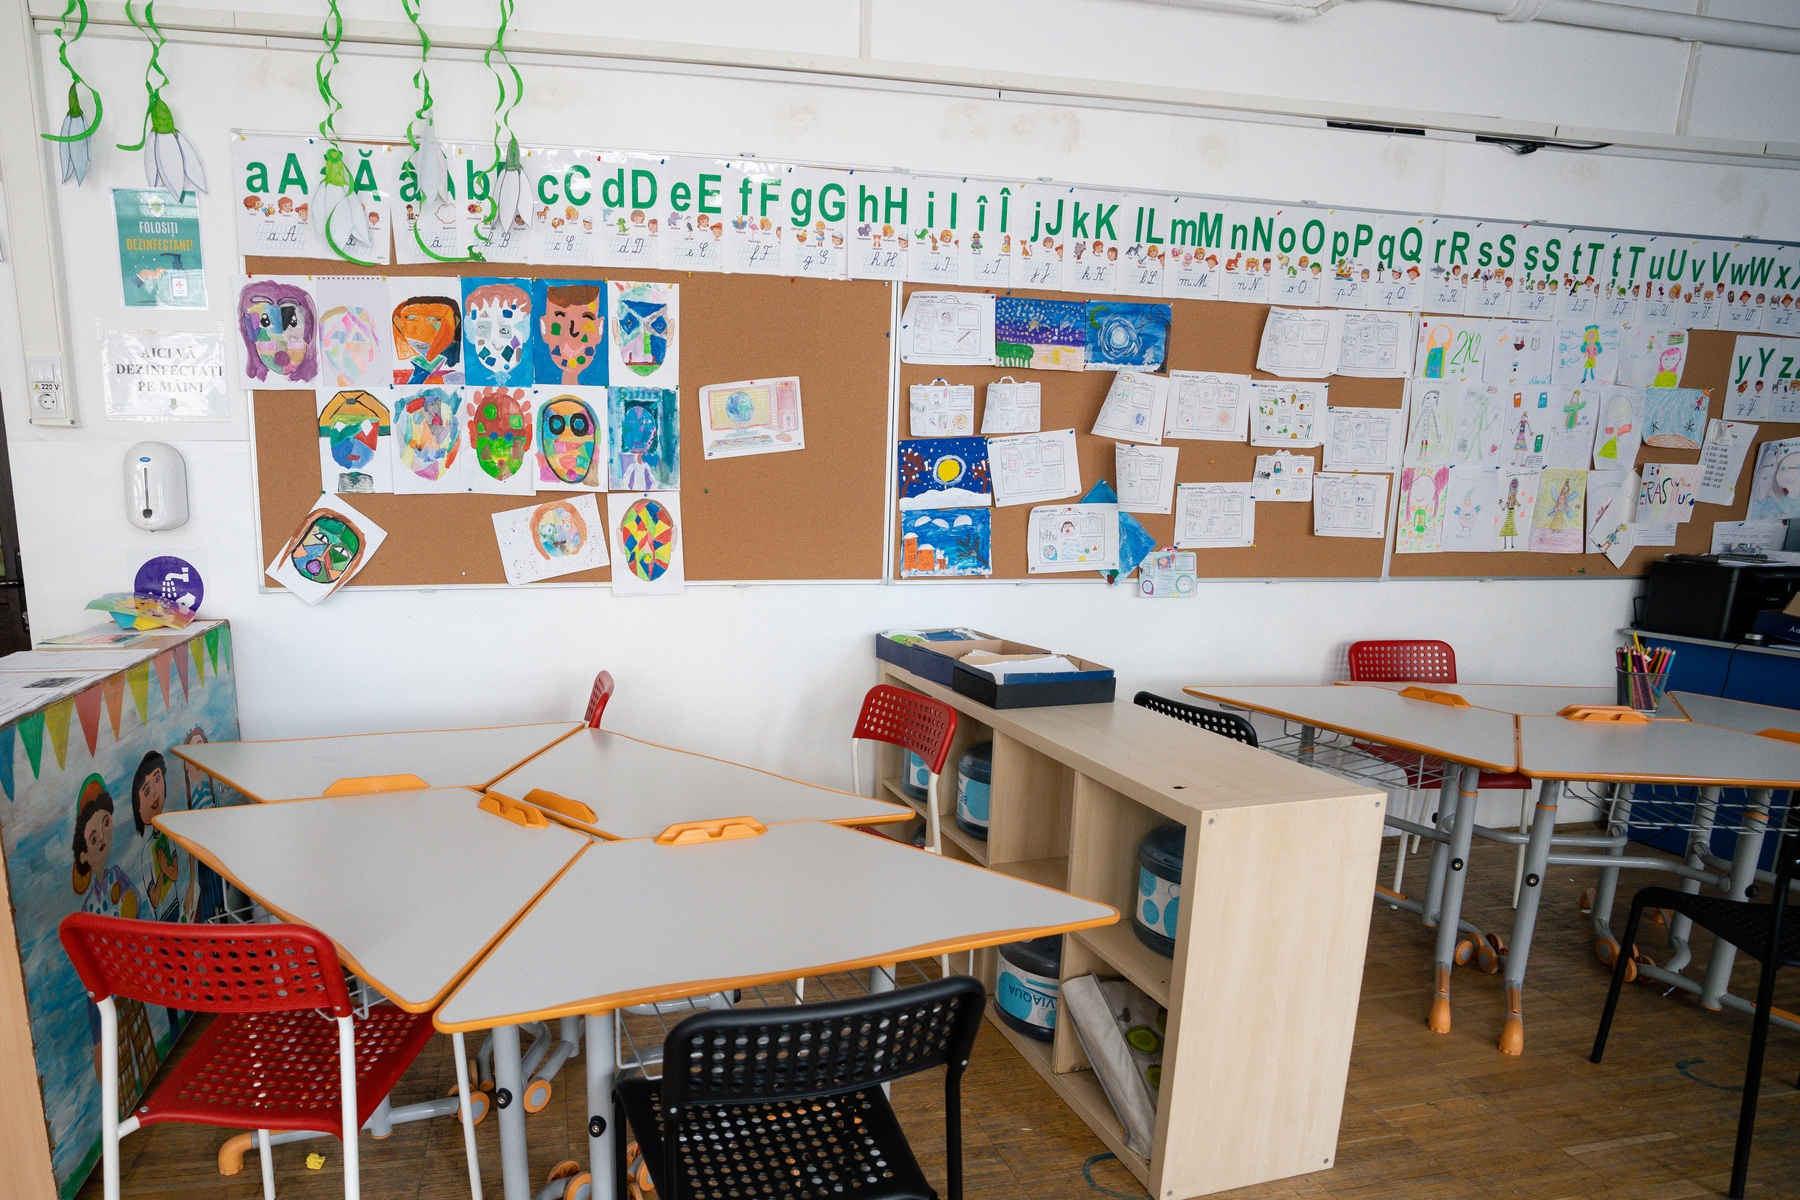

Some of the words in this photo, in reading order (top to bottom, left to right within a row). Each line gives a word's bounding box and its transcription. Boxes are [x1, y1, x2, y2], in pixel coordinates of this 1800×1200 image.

[126, 238, 193, 251] DEZINFECTANT!
[140, 348, 172, 359] AICI
[41, 383, 53, 391] 220
[55, 383, 60, 391] V
[138, 381, 155, 393] PE
